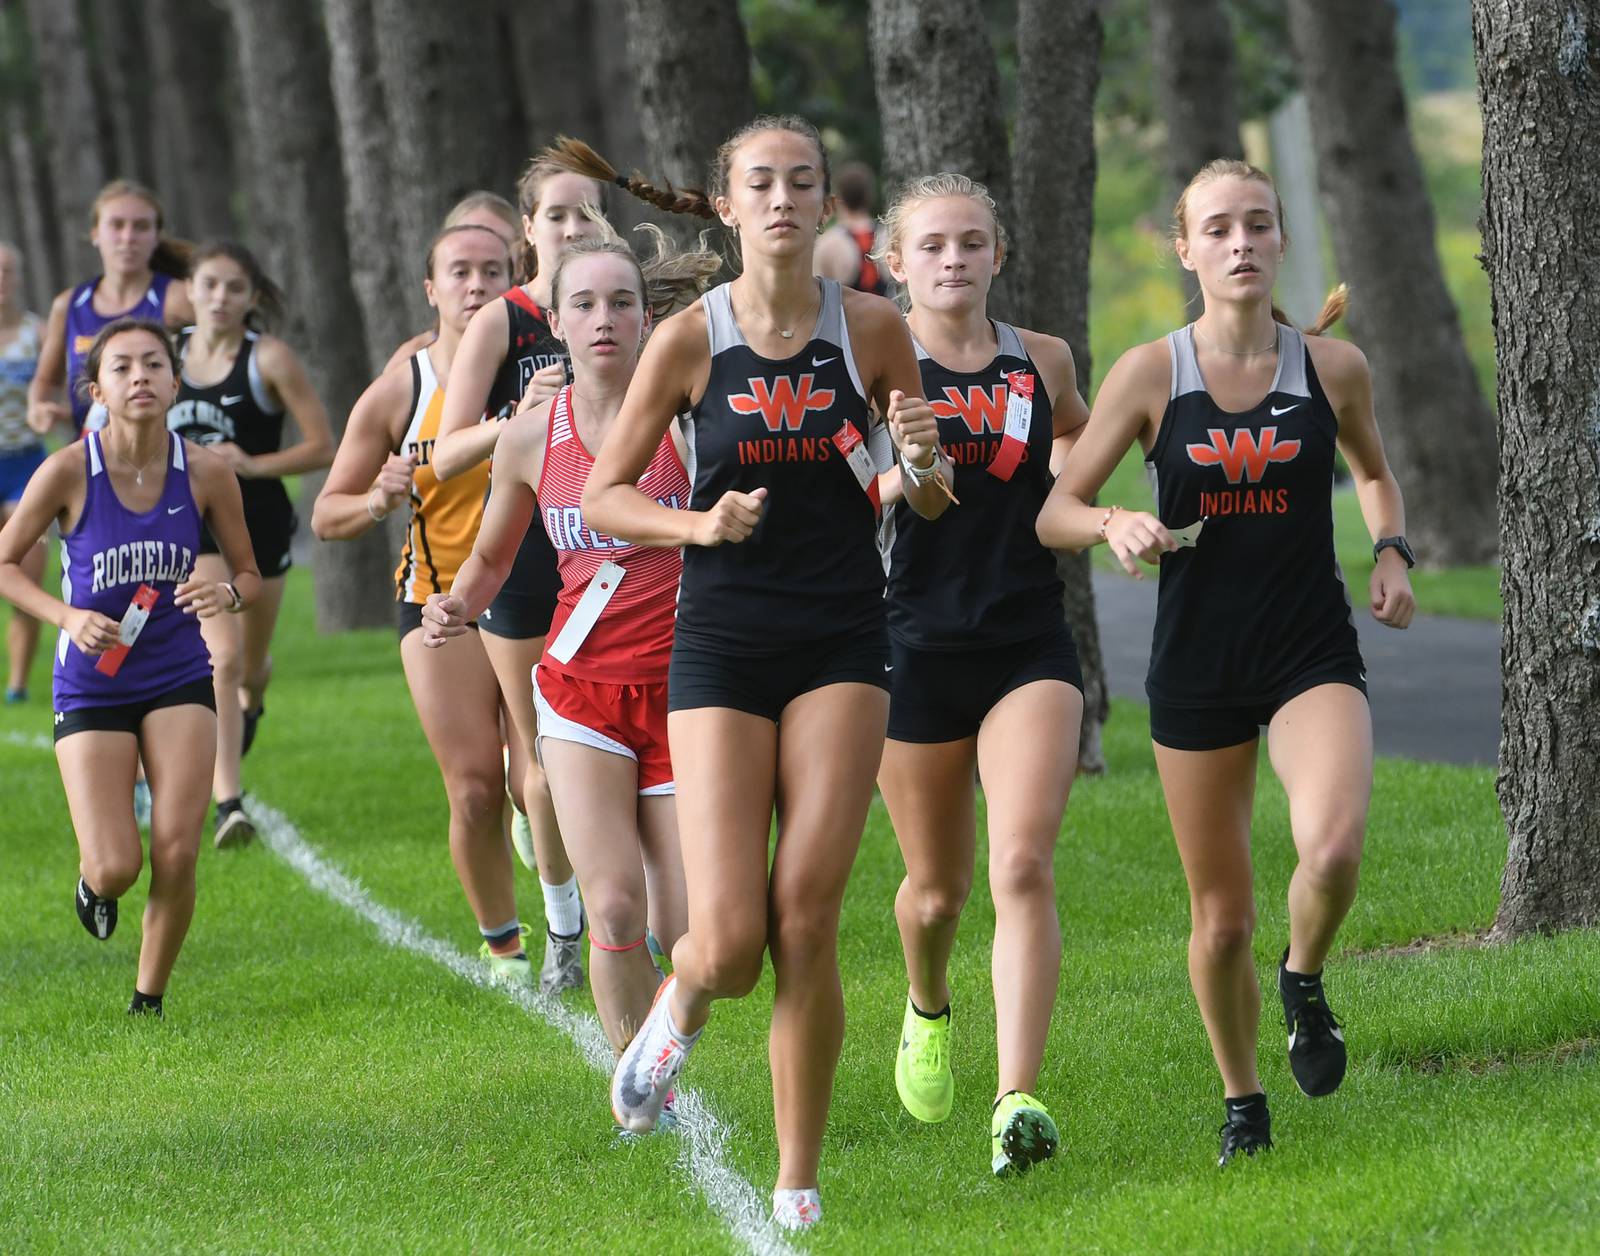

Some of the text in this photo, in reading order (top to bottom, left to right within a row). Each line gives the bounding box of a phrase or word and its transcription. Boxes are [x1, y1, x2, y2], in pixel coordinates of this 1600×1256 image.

[738, 437, 832, 465] INDIANS
[941, 440, 1031, 464] NDIA
[1200, 488, 1289, 517] INDIANS
[91, 540, 192, 594] ROCHELLE
